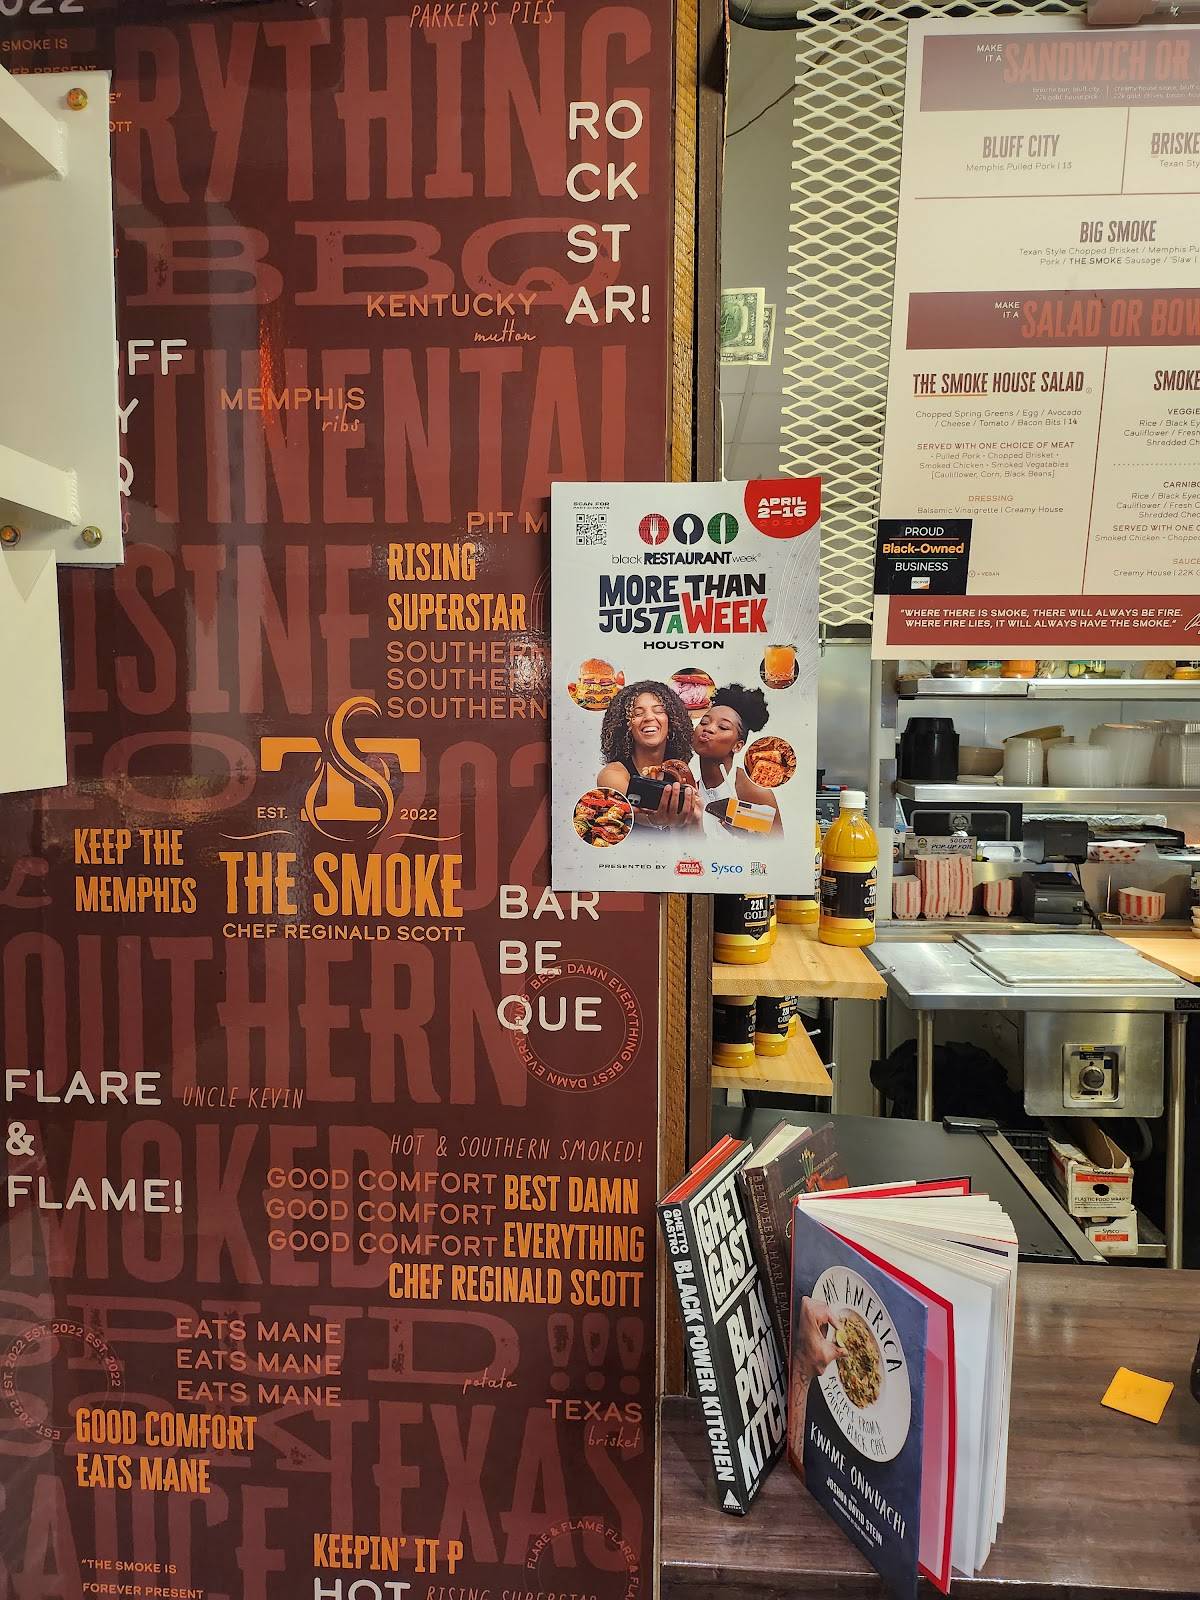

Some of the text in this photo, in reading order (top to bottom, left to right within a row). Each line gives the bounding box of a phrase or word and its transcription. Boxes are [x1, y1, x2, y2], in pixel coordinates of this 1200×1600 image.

[409, 0, 553, 28] PARKER'S PIES
[2, 39, 68, 51] SMOKE IS
[977, 44, 1003, 53] MAKE
[1003, 39, 1191, 83] SANDWICH OR
[569, 100, 643, 139] RO
[983, 134, 1060, 159] BLUFF CITY
[966, 162, 1056, 172] Memphis Pulled Pork
[566, 162, 638, 202] CK
[567, 224, 630, 263] ST
[1080, 220, 1157, 243] BIG SMOKE
[1020, 247, 1139, 257] Texan Style Chopped Brisket
[1069, 257, 1122, 265] THE SMOKE
[125, 217, 622, 326] BBQ
[367, 293, 538, 317] KENTUCKY
[565, 285, 649, 324] AR!
[995, 301, 1020, 309] MAKE
[1021, 299, 1142, 338] SALAD OR
[474, 319, 536, 343] mutton
[913, 371, 1084, 394] THE SMOKE HOUSE SALAD
[220, 387, 366, 411] MEMPHIS
[322, 403, 360, 432] ribs
[915, 411, 951, 419] Chopped
[955, 410, 981, 419] Spring
[1022, 410, 1038, 418] Egg
[758, 497, 807, 506] APRIL
[467, 512, 514, 534] PIT
[904, 527, 944, 536] PROUD
[387, 543, 476, 581] RISING
[612, 552, 732, 566] black RESTAURANT
[882, 543, 965, 554] Black-Owned
[895, 562, 949, 571] BUSINESS
[599, 573, 766, 608] MORE THAN
[387, 592, 527, 631] SUPERSTAR
[599, 592, 768, 633] JUST A WEEK
[944, 609, 975, 617] THERE
[978, 609, 988, 617] IS
[991, 609, 1029, 619] SMOKE,
[1033, 609, 1066, 617] THERE
[1069, 609, 1093, 617] WILL
[1096, 609, 1138, 617] ALWAYS
[1141, 609, 1155, 617] BE
[1158, 609, 1183, 617] FIRE.
[969, 620, 993, 629] LIES,
[643, 640, 724, 650] HOUSTON
[387, 696, 548, 719] SOUTHERN
[257, 806, 438, 821] EST. 2022
[74, 828, 184, 866] KEEP THE
[711, 862, 743, 875] Sysco
[75, 876, 197, 914] MEMPHIS
[219, 852, 464, 918] THE SMOKE
[499, 884, 600, 921] BAR
[222, 923, 466, 942] CHEF REGINALD SCOTT
[499, 940, 562, 975] BE
[496, 994, 603, 1035] QUE
[567, 963, 641, 1062] DAMN EVERYTHING
[5, 1068, 162, 1106] FLARE
[183, 1085, 305, 1109] UNCLE KEVIN
[5, 1121, 35, 1156] &
[390, 1134, 644, 1164] HOT SOUTHERN SMOKED!
[8, 1175, 183, 1214] FLAME!
[267, 1167, 498, 1195] GOOD COMFORT
[504, 1174, 639, 1215] BEST DAMN
[266, 1199, 498, 1226] GOOD COMFORT
[267, 1230, 499, 1257] GOOD COMFORT
[504, 1221, 645, 1262] EVERYTHING
[663, 1209, 680, 1255] GASTRO
[672, 1208, 689, 1254] GHETTO
[388, 1262, 644, 1308] CHEF REGINALD SCOTT
[673, 1260, 704, 1324] BLACK
[176, 1317, 342, 1345] EATS MANE
[176, 1348, 342, 1376] EATS MANE
[687, 1325, 717, 1392] POWER
[177, 1379, 342, 1408] EATS MANE
[462, 1367, 518, 1395] potato
[546, 1398, 643, 1424] TEXAS
[75, 1407, 258, 1452] GOOD COMFORT
[588, 1425, 642, 1450] brisket
[701, 1396, 736, 1482] KITCHEN
[810, 1421, 846, 1476] KWAME
[76, 1453, 211, 1494] EATS MANE
[850, 1465, 906, 1540] ONWUACHI
[115, 1560, 161, 1574] SMOKE
[164, 1562, 178, 1575] IS
[313, 1533, 441, 1574] KEEPIN' IT
[82, 1582, 204, 1600] FOREVER PRESENT
